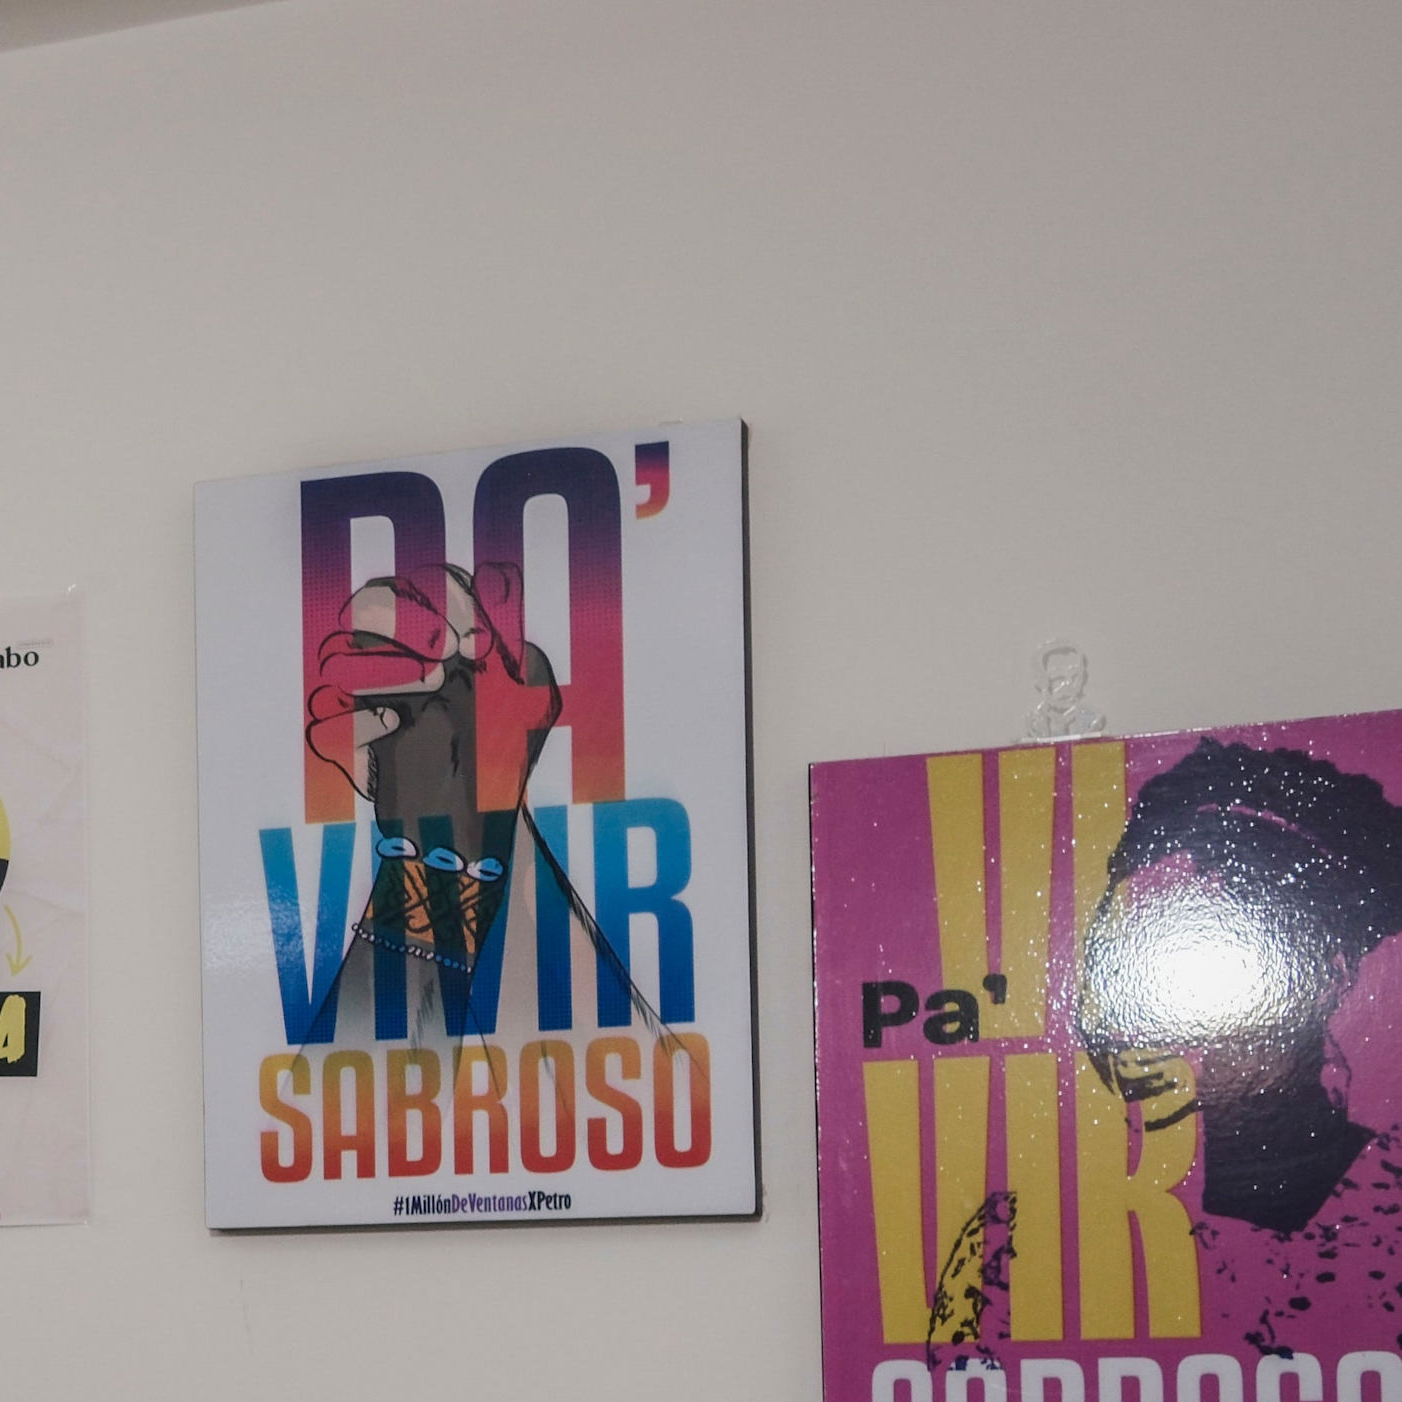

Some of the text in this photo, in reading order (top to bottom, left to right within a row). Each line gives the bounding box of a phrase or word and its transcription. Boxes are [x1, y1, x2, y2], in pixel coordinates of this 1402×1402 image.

[259, 798, 695, 1044] VIVIR
[862, 973, 1007, 1048] Pa'
[258, 1032, 712, 1184] SABROSO
[394, 1190, 572, 1217] #1MillónDeVentanasXPetro
[863, 1046, 1201, 1344] VIR
